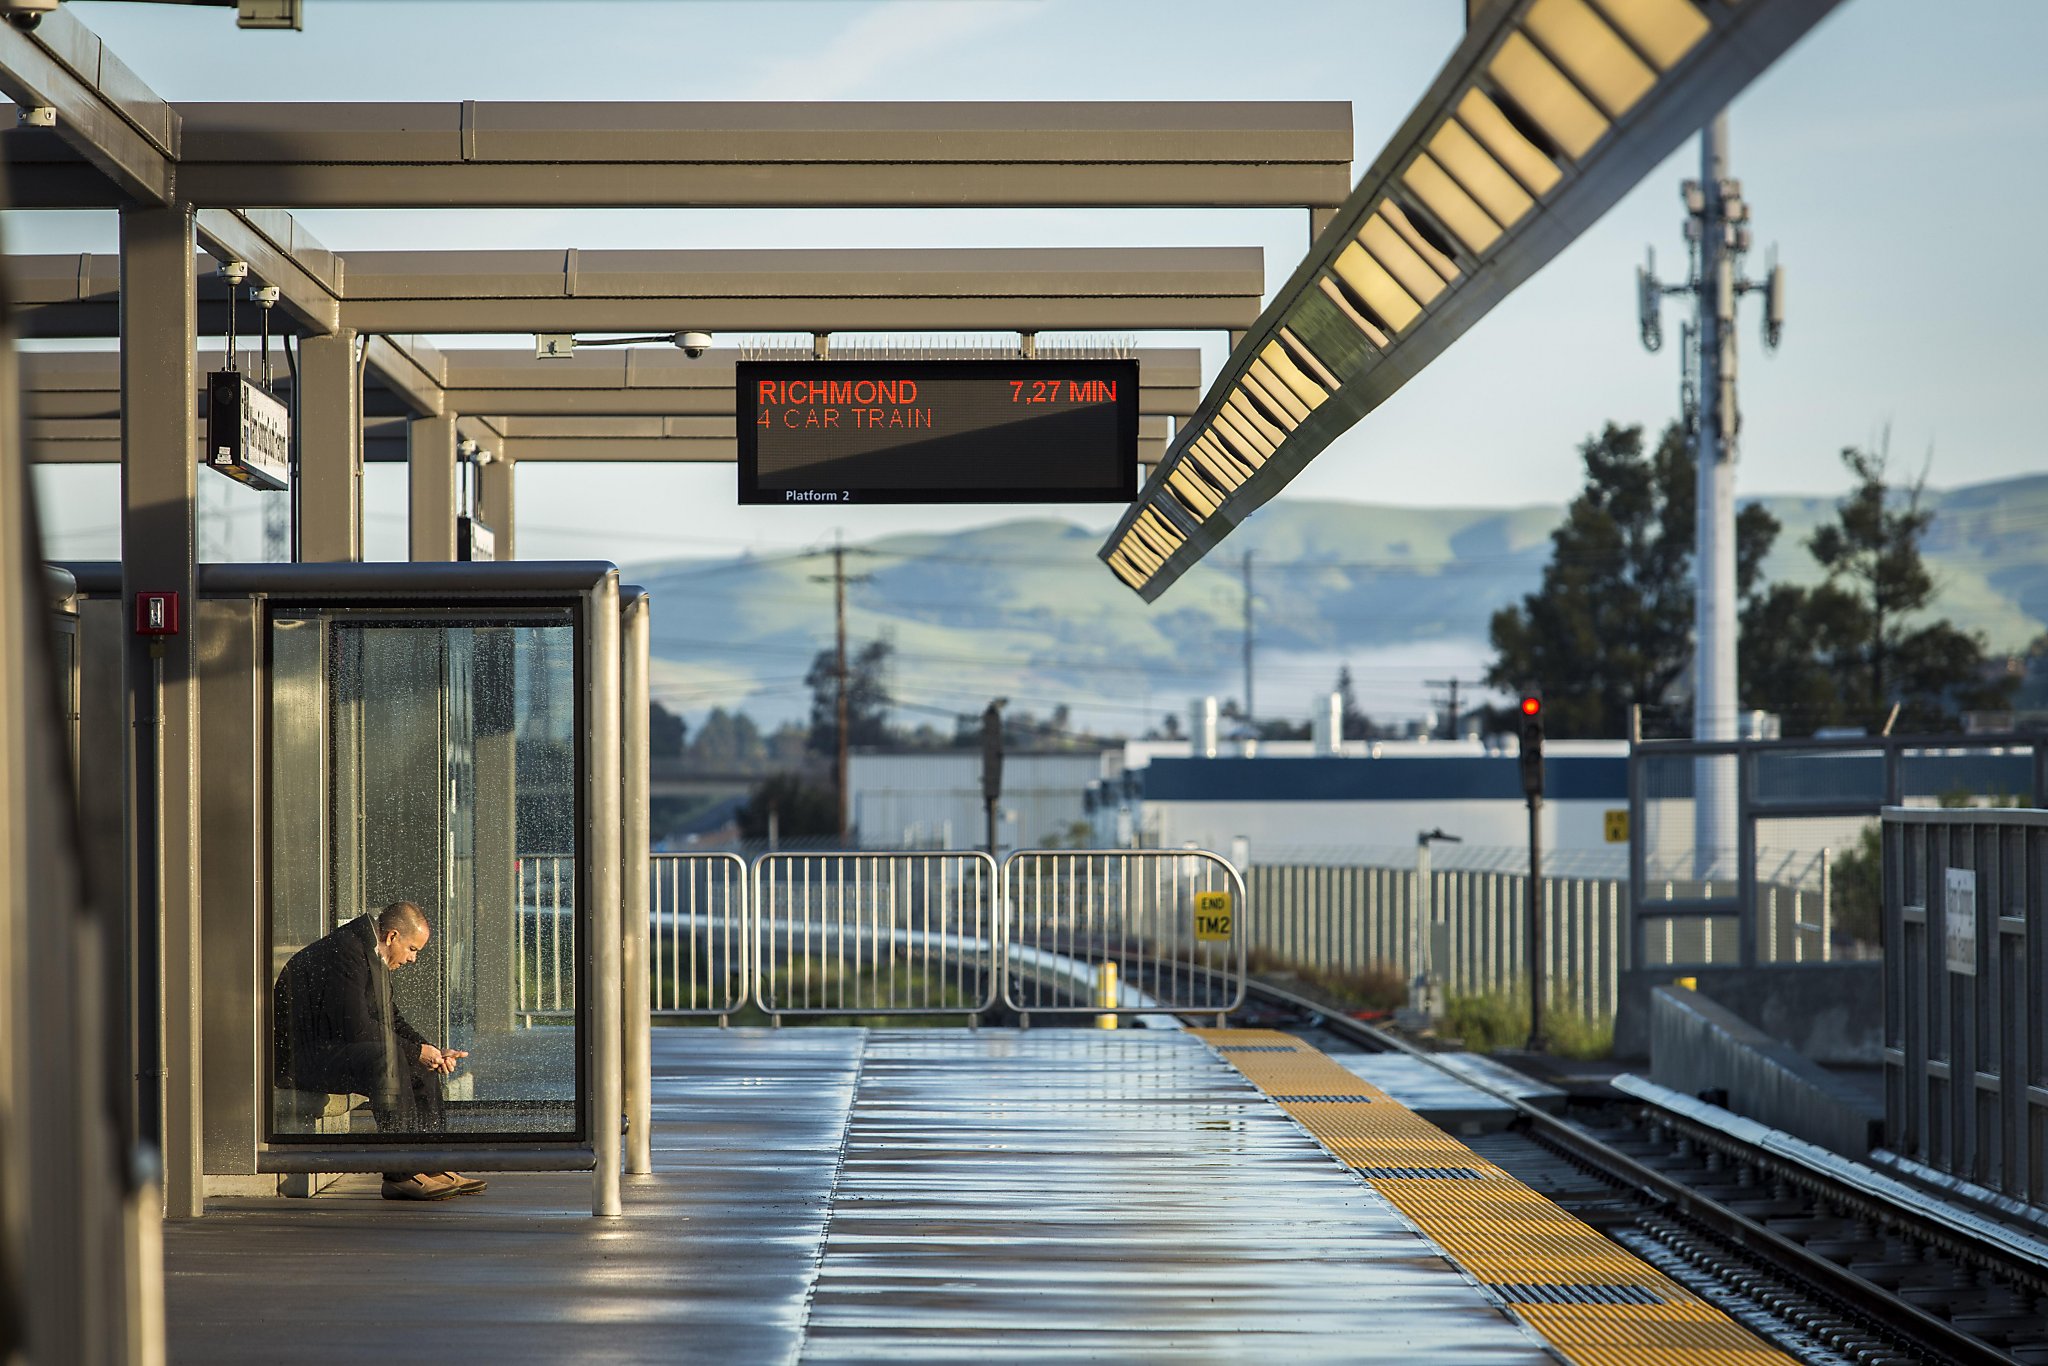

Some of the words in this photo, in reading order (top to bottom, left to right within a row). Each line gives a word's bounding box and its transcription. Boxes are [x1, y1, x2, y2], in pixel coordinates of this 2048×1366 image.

[759, 380, 918, 405] RICHMOND
[1009, 381, 1061, 405] 7,27
[1069, 380, 1117, 402] MIN
[757, 408, 770, 428] 4
[783, 408, 840, 429] CAR
[851, 408, 932, 428] TRAIN
[785, 489, 838, 501] Platform
[842, 490, 850, 501] 2
[1201, 896, 1225, 911] END
[1197, 916, 1230, 934] TM2
